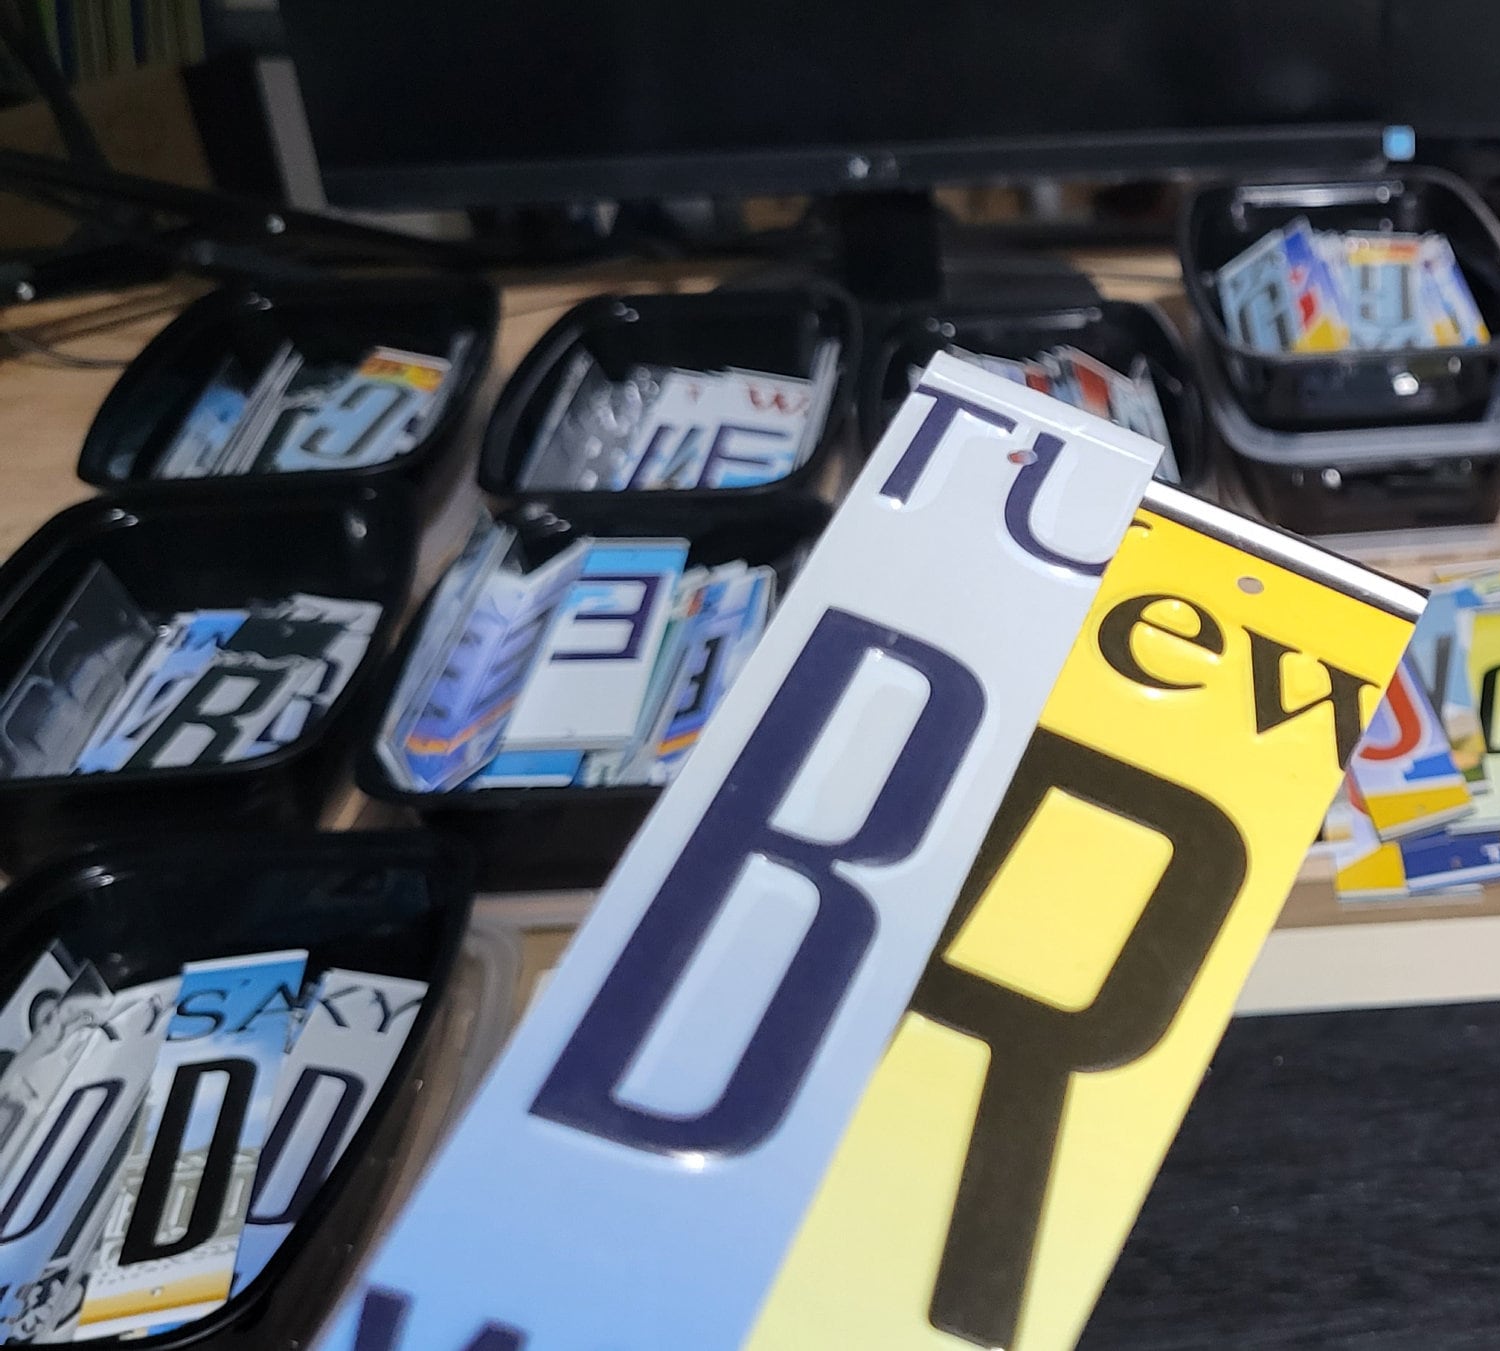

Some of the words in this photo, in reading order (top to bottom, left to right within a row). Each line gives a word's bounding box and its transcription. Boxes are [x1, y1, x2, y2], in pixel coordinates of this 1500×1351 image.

[1099, 517, 1379, 772] ew
[526, 607, 988, 1156] B
[911, 724, 1250, 1351] R
[117, 1058, 258, 1267] D
